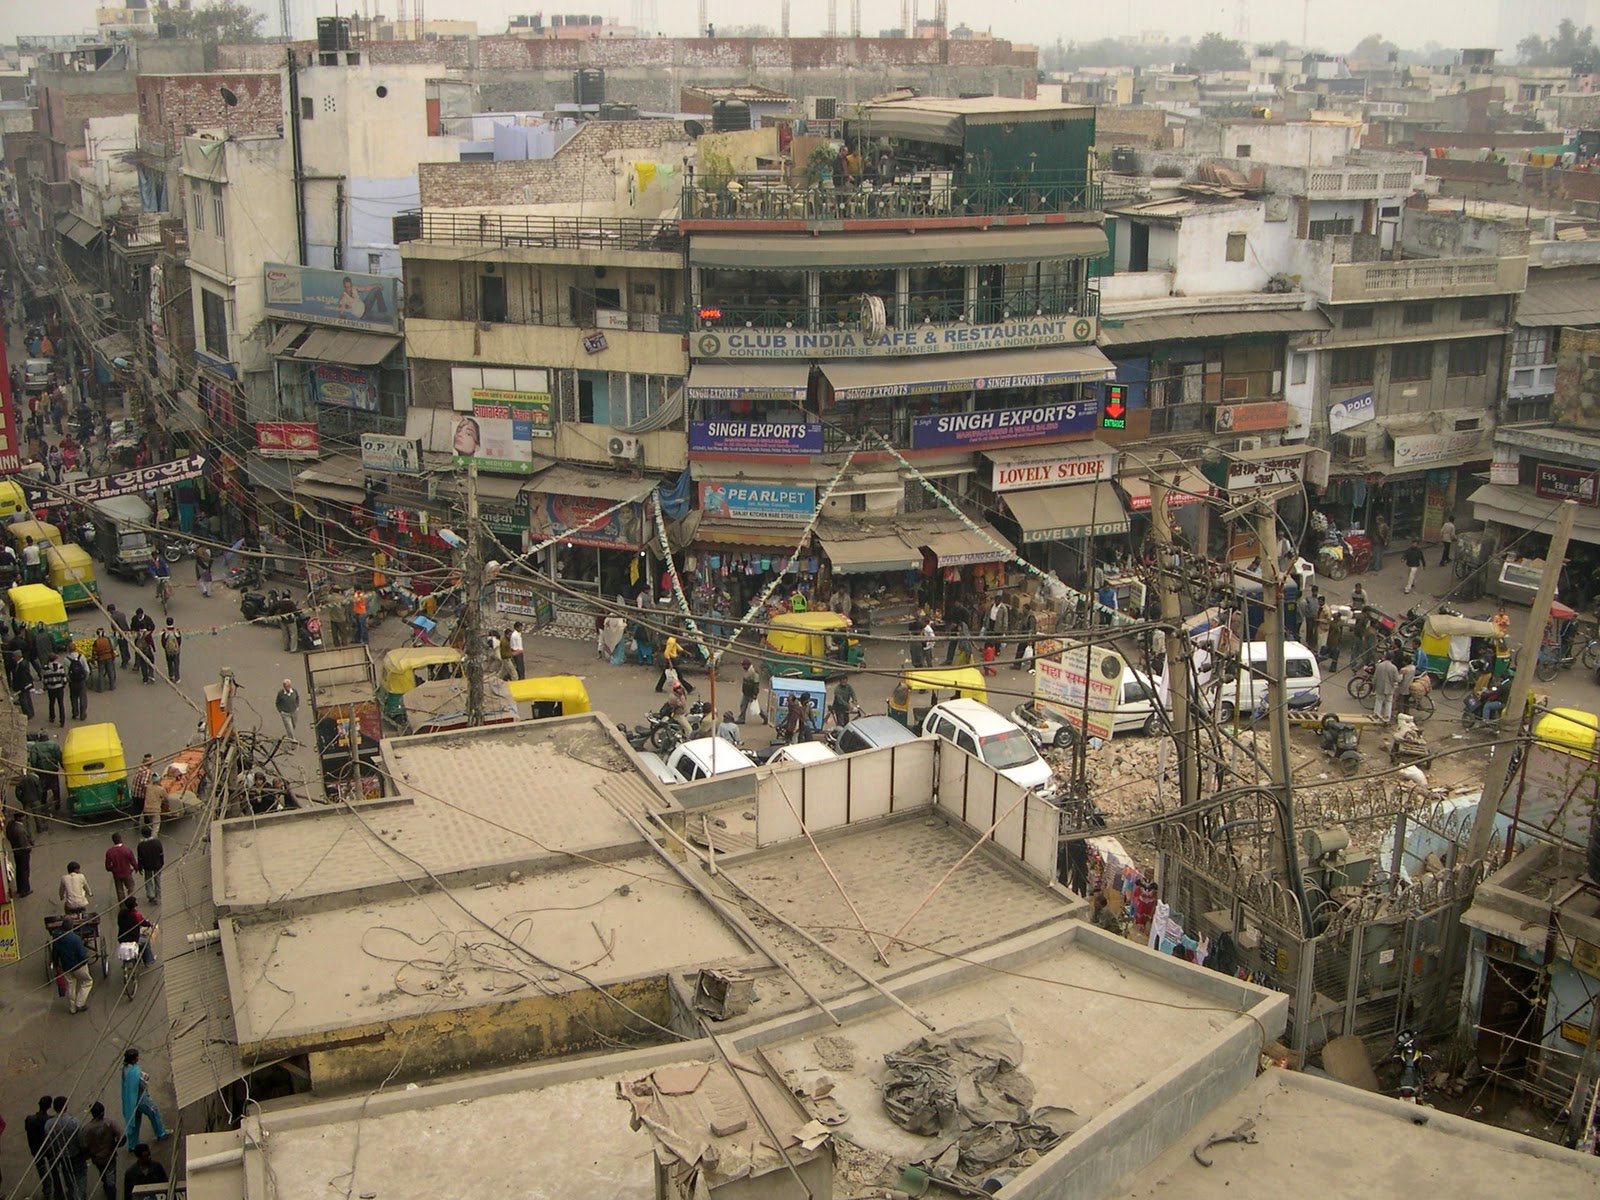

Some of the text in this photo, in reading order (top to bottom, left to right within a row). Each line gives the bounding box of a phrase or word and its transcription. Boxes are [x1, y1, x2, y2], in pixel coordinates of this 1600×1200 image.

[728, 334, 787, 349] CLUB
[795, 333, 857, 348] INDIA
[923, 331, 938, 344] &
[944, 321, 1067, 343] RESTAURANT
[729, 348, 811, 357] CONTINENTAL
[823, 347, 873, 357] CHINESE
[885, 344, 940, 355] JAPANESE
[951, 340, 992, 351] TIBETAN
[1003, 336, 1037, 347] INDIAN
[1038, 333, 1066, 344] FOOD
[987, 376, 1012, 389] SINGH
[1012, 374, 1045, 388] EXPORTS
[689, 388, 709, 399] SINGH
[710, 388, 739, 399] EXPORTS
[846, 387, 872, 400] SINGH
[873, 385, 908, 398] EXPORTS
[1346, 396, 1373, 413] POLO
[937, 413, 995, 433] SINGH
[998, 404, 1077, 428] EXPORTS
[708, 422, 747, 437] SINGH
[750, 423, 806, 439] EXPORTS
[999, 465, 1053, 485] LOVELY
[1057, 459, 1106, 478] STORE
[1542, 472, 1557, 482] ESS
[728, 488, 806, 504] PEARLPET
[749, 510, 768, 518] KITCHEN
[1023, 521, 1131, 543] LOVELY STORE
